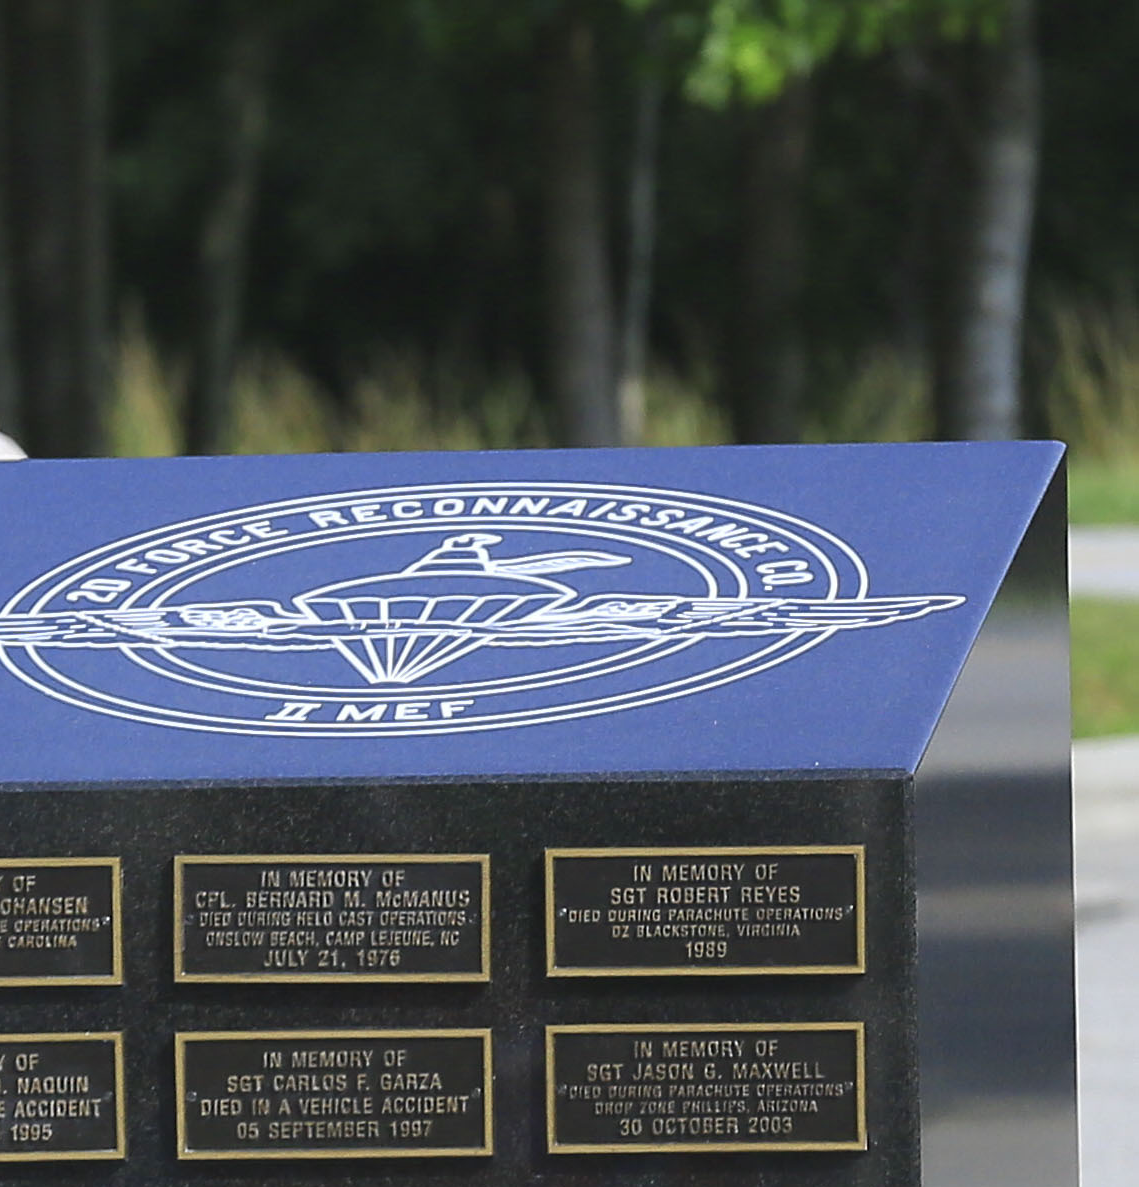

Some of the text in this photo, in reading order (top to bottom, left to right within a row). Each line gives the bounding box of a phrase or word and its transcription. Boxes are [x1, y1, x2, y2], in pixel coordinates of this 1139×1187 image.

[66, 496, 815, 602] 2D FORCE RECONNAISSANCE CO.
[264, 699, 475, 721] II MEF
[261, 869, 404, 888] IN MEMORY OF
[634, 863, 778, 881] IN MEMORY OF
[13, 875, 35, 892] OF
[246, 890, 334, 909] BERNARD
[344, 890, 365, 907] M.
[376, 888, 469, 908] McMANUS
[611, 885, 800, 904] SGT ROBERT REYES
[569, 906, 842, 922] DIED DURING PARACHUTE OPERATIONS
[206, 930, 265, 946] ONSLOW
[326, 930, 364, 946] CAMP
[612, 925, 629, 938] DZ
[737, 922, 800, 937] VIRGINIA
[264, 948, 400, 968] JULY 21, 1976
[685, 940, 727, 958] 1989
[634, 1039, 777, 1058] IN MEMORY OF
[15, 1053, 38, 1071] OF
[263, 1049, 406, 1068] IN MEMORY OF
[587, 1061, 824, 1081] SGT JASON G. MAXWELL
[17, 1075, 88, 1094] NAQUIN
[227, 1074, 263, 1092] SGT
[273, 1073, 346, 1092] CARLOS
[380, 1072, 442, 1090] GARZA
[14, 1098, 101, 1118] ACCIDENT
[200, 1095, 468, 1115] DIED IN A VEHICLE ACCIDENT
[10, 1123, 52, 1141] 1995
[237, 1119, 432, 1139] 05 SEPTEMBER 1997
[620, 1115, 792, 1135] 30 OCTOBER 2003
